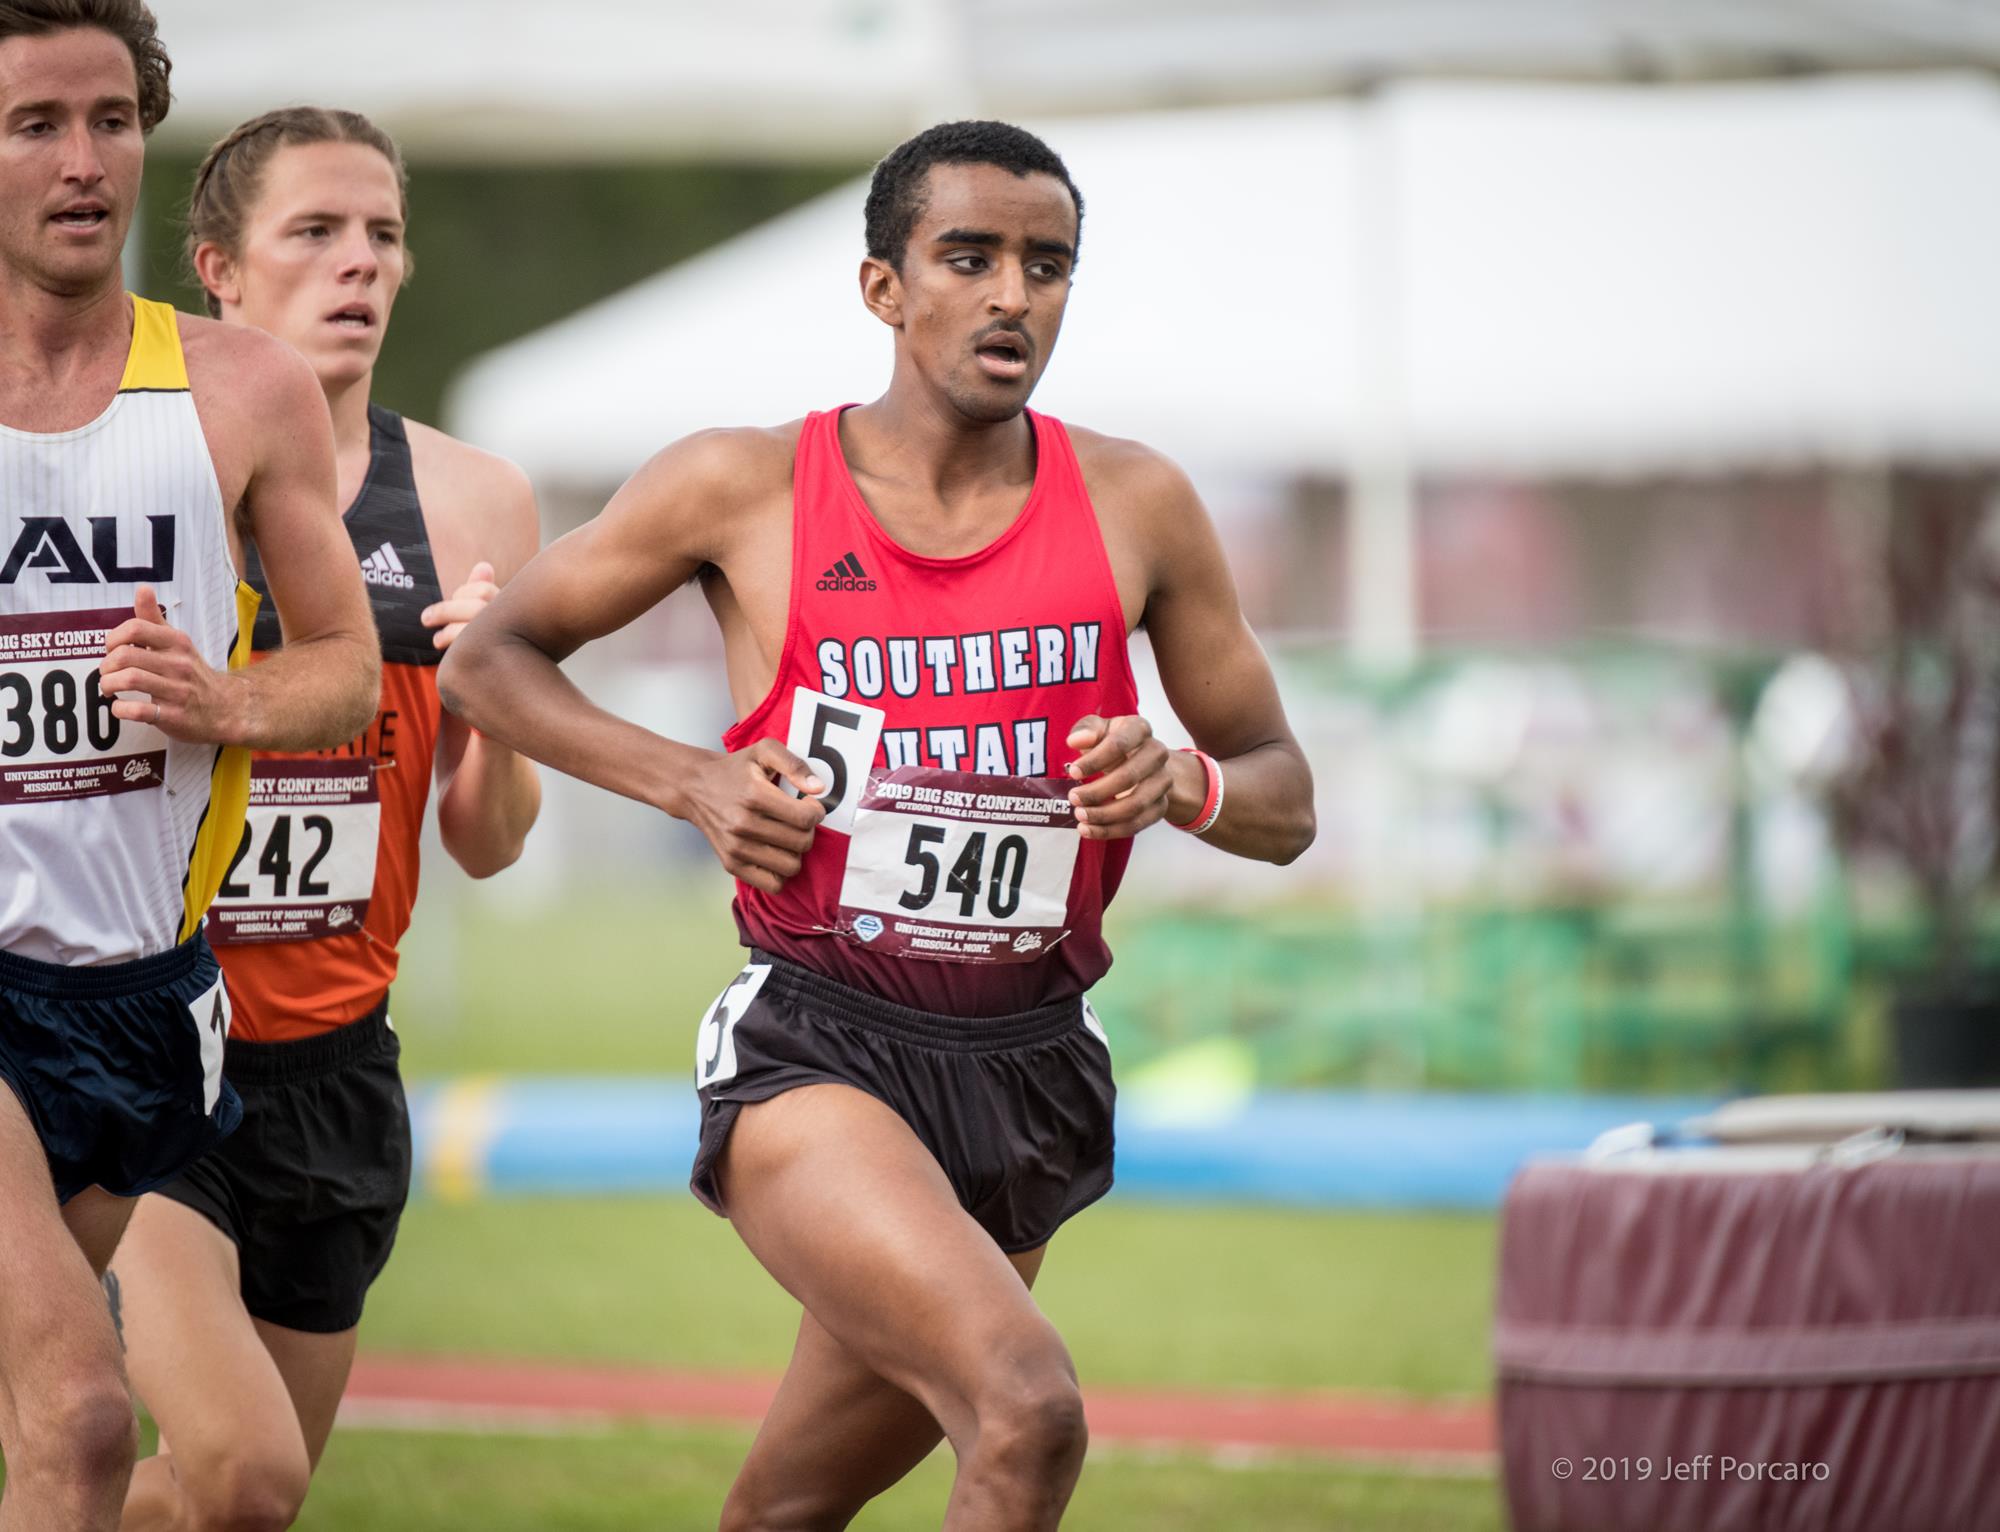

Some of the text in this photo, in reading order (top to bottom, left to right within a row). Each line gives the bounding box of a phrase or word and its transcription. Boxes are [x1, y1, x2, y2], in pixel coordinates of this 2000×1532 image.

[0, 514, 175, 583] AU
[816, 576, 877, 591] adidas
[21, 633, 52, 648] SKY
[54, 629, 112, 647] CONFE
[15, 650, 41, 659] TRACK
[41, 649, 48, 657] &
[49, 647, 71, 657] FIELD
[817, 621, 1101, 699] SOUTHERN
[0, 668, 120, 758] 386
[880, 717, 1048, 778] UTAH
[797, 702, 861, 815] 5
[4, 764, 118, 782] UNIVERSITY OF MONTANA
[23, 779, 101, 793] MISSOULA, MONT.
[277, 776, 369, 793] CONFERENCE
[876, 783, 1071, 814] 2019 BIG SKY CONFERENCE
[895, 801, 933, 812] OUTDOOR
[933, 806, 961, 816] TRACK
[967, 810, 991, 819] FIELD
[991, 812, 1050, 823] CHAMPIONSHIPS
[218, 815, 333, 897] 242
[898, 823, 1028, 919] 540
[219, 909, 324, 922] UNIVERSITY OF MONTANA
[281, 921, 308, 932] MONT.
[894, 922, 954, 939] UNIVERSITY
[954, 929, 968, 940] OF
[968, 931, 1010, 942] MONTANA
[962, 943, 991, 953] MONT.
[705, 971, 754, 1078] 5
